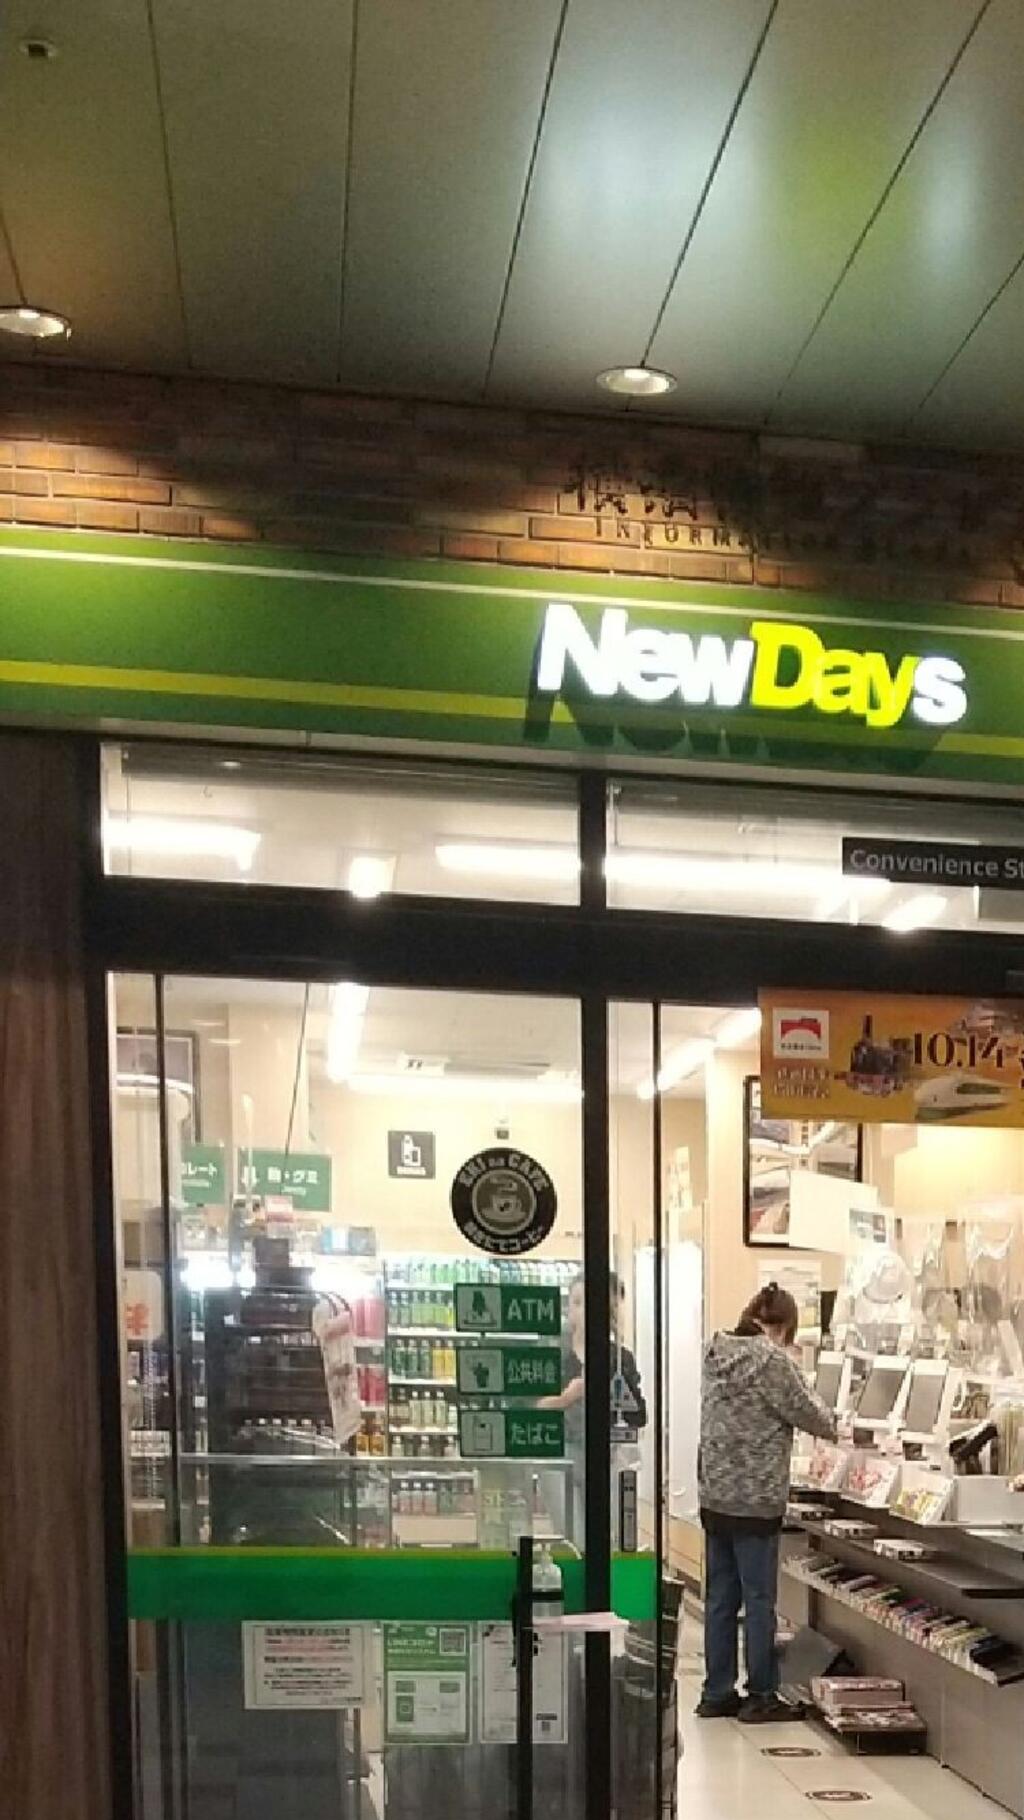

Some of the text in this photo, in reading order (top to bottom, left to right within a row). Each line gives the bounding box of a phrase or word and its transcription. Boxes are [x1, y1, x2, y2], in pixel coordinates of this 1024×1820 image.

[538, 602, 967, 727] NewDays
[850, 849, 999, 876] Convenience
[507, 1299, 554, 1321] ATM
[511, 1421, 561, 1446] たばこ
